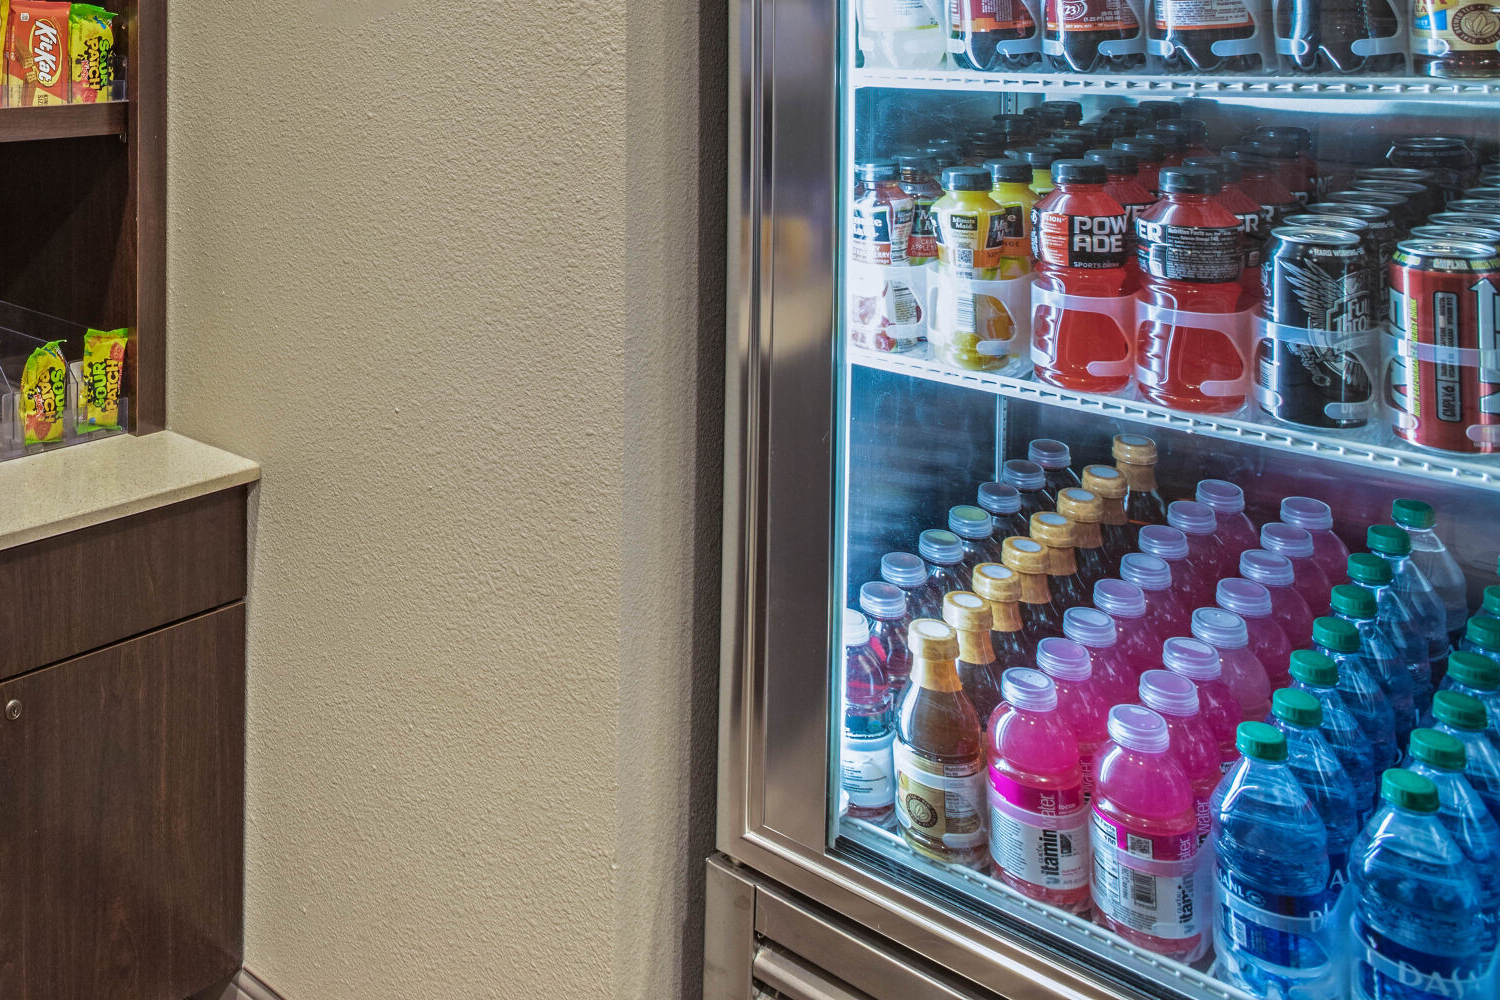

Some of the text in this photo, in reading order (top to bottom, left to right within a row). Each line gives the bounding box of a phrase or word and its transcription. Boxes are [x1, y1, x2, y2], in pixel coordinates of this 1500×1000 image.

[1065, 5, 1077, 15] 23
[88, 38, 101, 91] PATCH
[99, 38, 108, 87] SOUR
[1073, 216, 1127, 235] POW
[1073, 234, 1123, 253] ADE
[1073, 261, 1100, 269] SPORTS
[38, 370, 57, 424] PATCH
[50, 369, 66, 420] SOUR
[92, 361, 107, 409] SOUR
[105, 359, 120, 412] PATCH
[1441, 385, 1456, 418] CMPLX6
